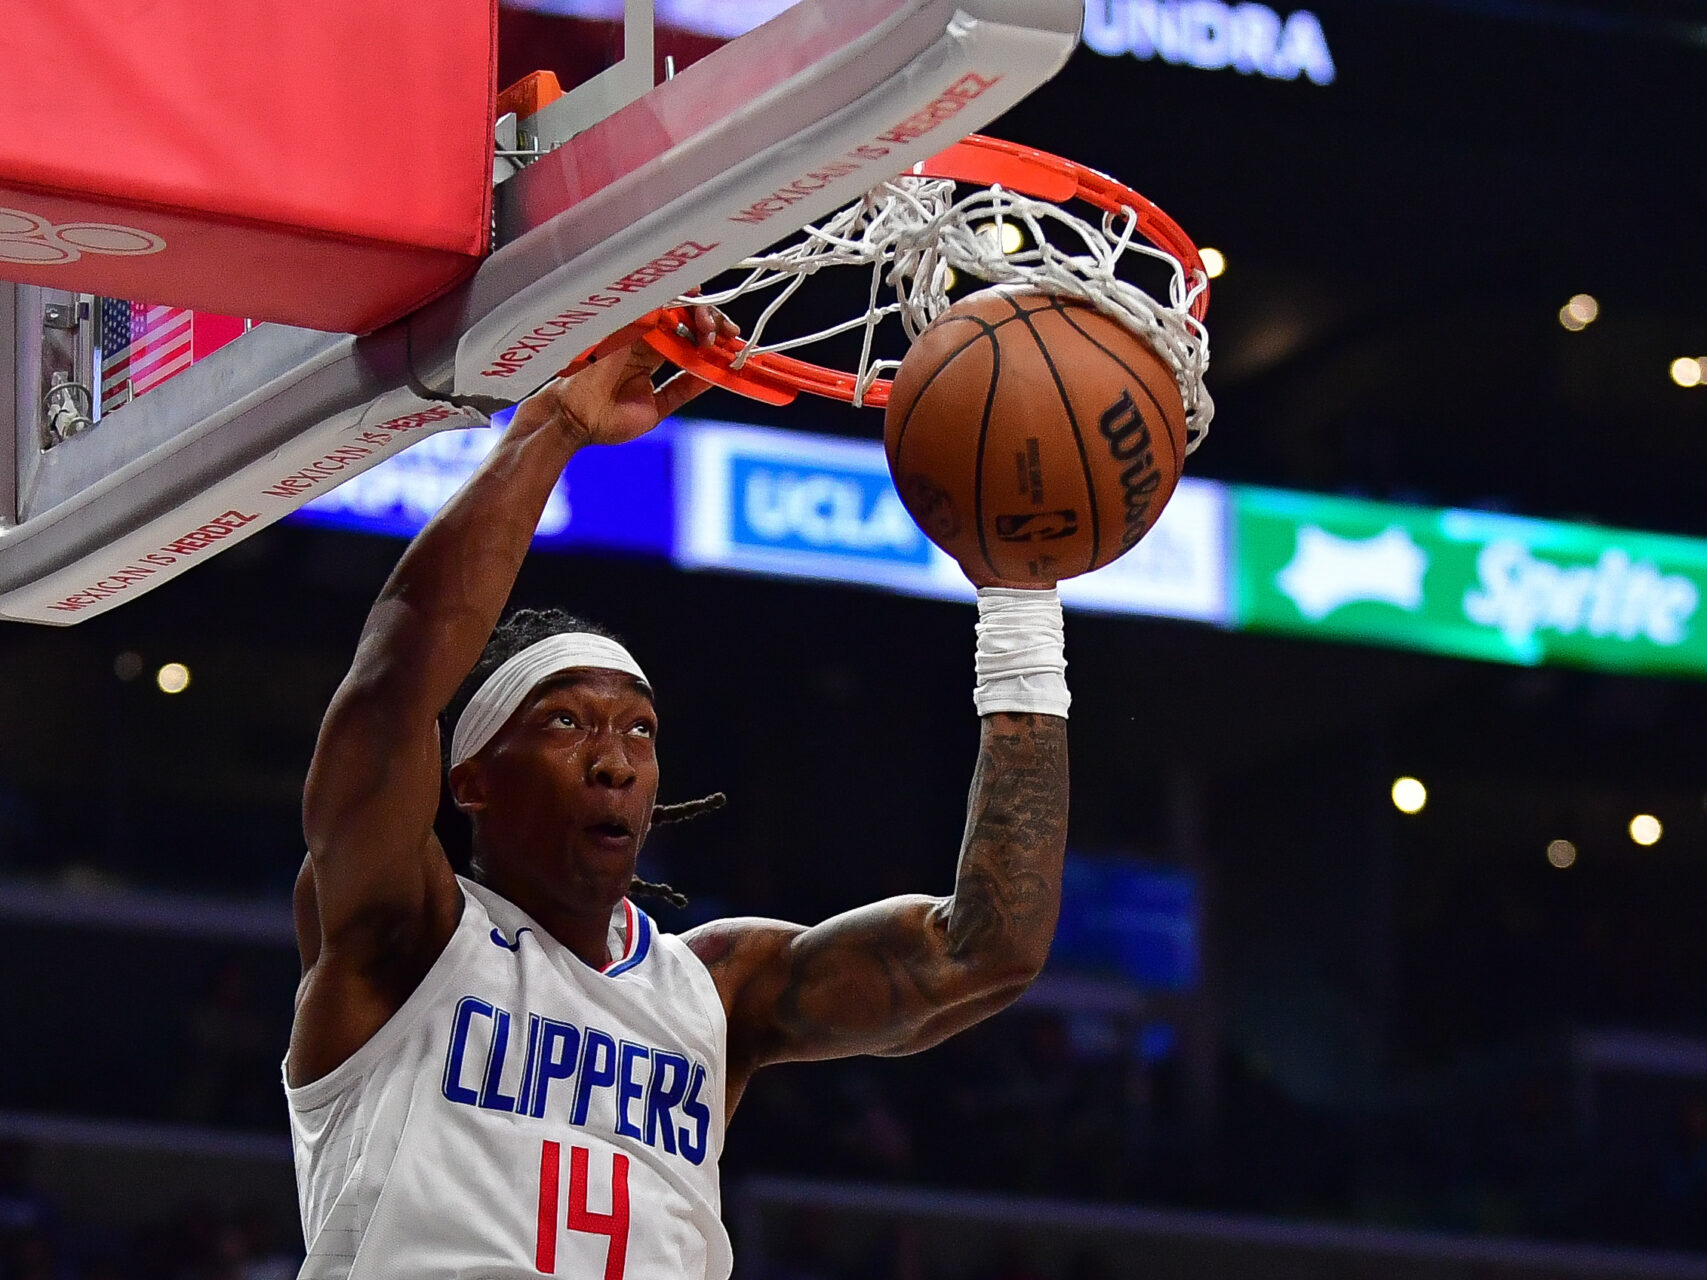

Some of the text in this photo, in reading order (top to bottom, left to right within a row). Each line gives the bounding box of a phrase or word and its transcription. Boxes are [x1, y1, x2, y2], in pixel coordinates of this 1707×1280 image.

[1083, 0, 1336, 86] UNDRA
[604, 240, 721, 293] HERDEZ
[1099, 388, 1161, 556] Wilso
[138, 553, 177, 567] IS
[160, 510, 262, 556] HERDEZ
[1462, 538, 1699, 666] Sprite
[441, 995, 711, 1167] CLIPPERS
